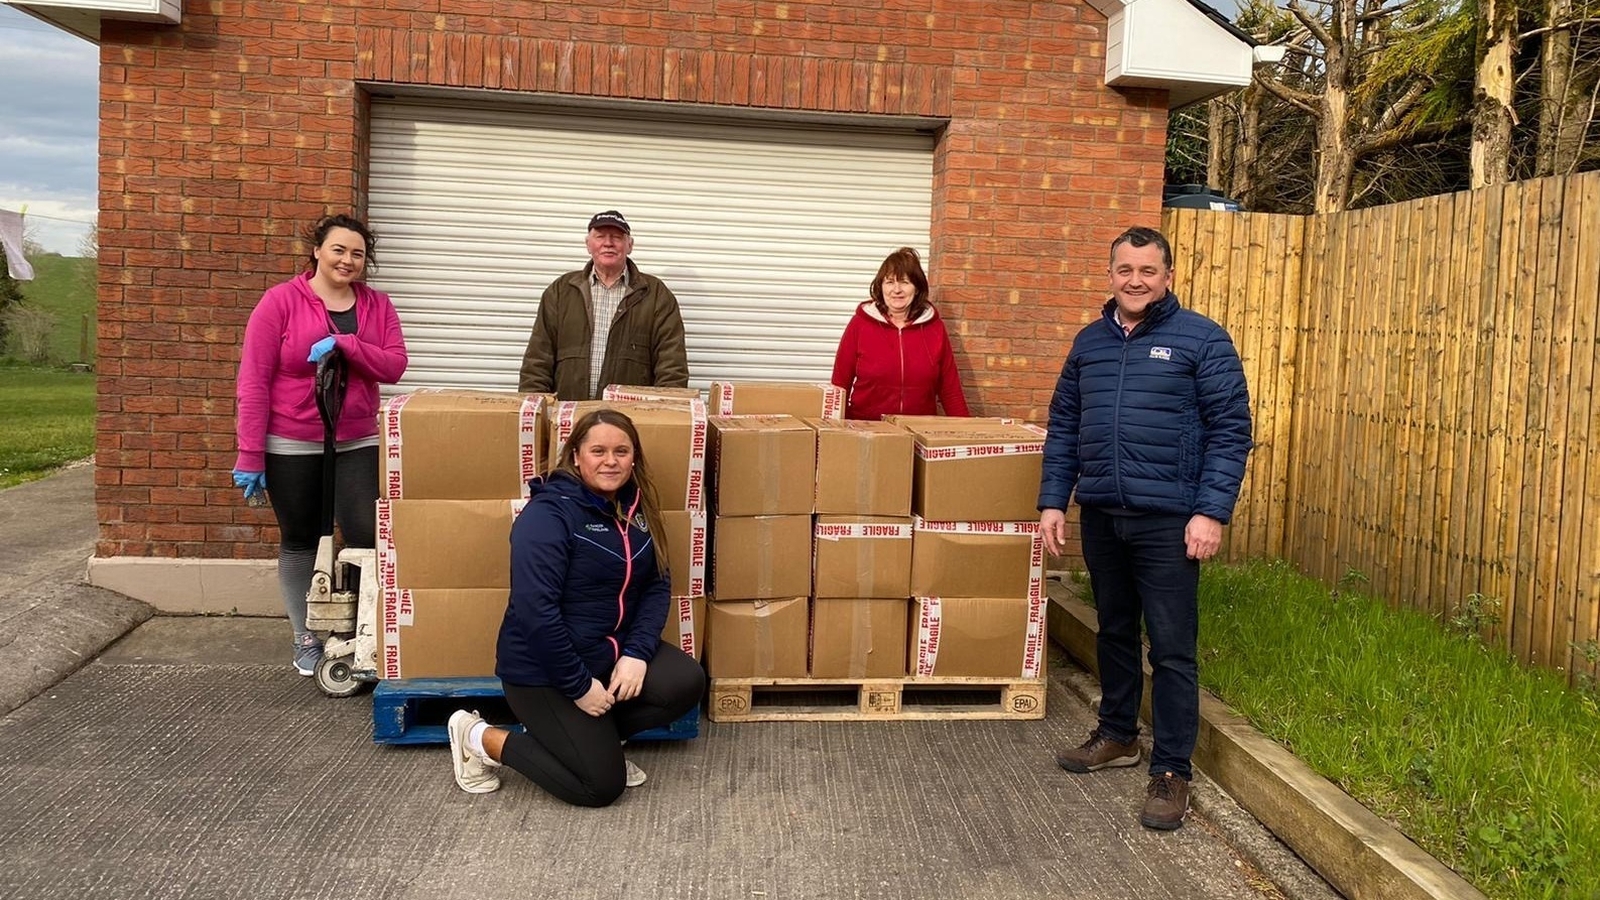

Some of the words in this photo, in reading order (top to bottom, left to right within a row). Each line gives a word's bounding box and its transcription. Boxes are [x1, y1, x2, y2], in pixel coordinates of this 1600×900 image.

[824, 390, 834, 420] FRAGIL
[924, 447, 956, 459] FRAGIL
[966, 445, 1004, 456] FRAGILE
[1015, 443, 1043, 453] AGILE
[389, 470, 400, 500] FRAGI
[687, 470, 702, 509] FRAGILE
[862, 525, 900, 536] FRAGILE
[967, 521, 1004, 532] FRAGILE
[1014, 522, 1040, 533] AGILE
[692, 527, 704, 567] FRAGILE
[1032, 537, 1042, 567] FRAGIL
[385, 592, 397, 633] FRAGILE
[928, 616, 940, 654] FRAGILE
[386, 645, 398, 680] FRAGIL
[1025, 633, 1037, 670] FRAGILE
